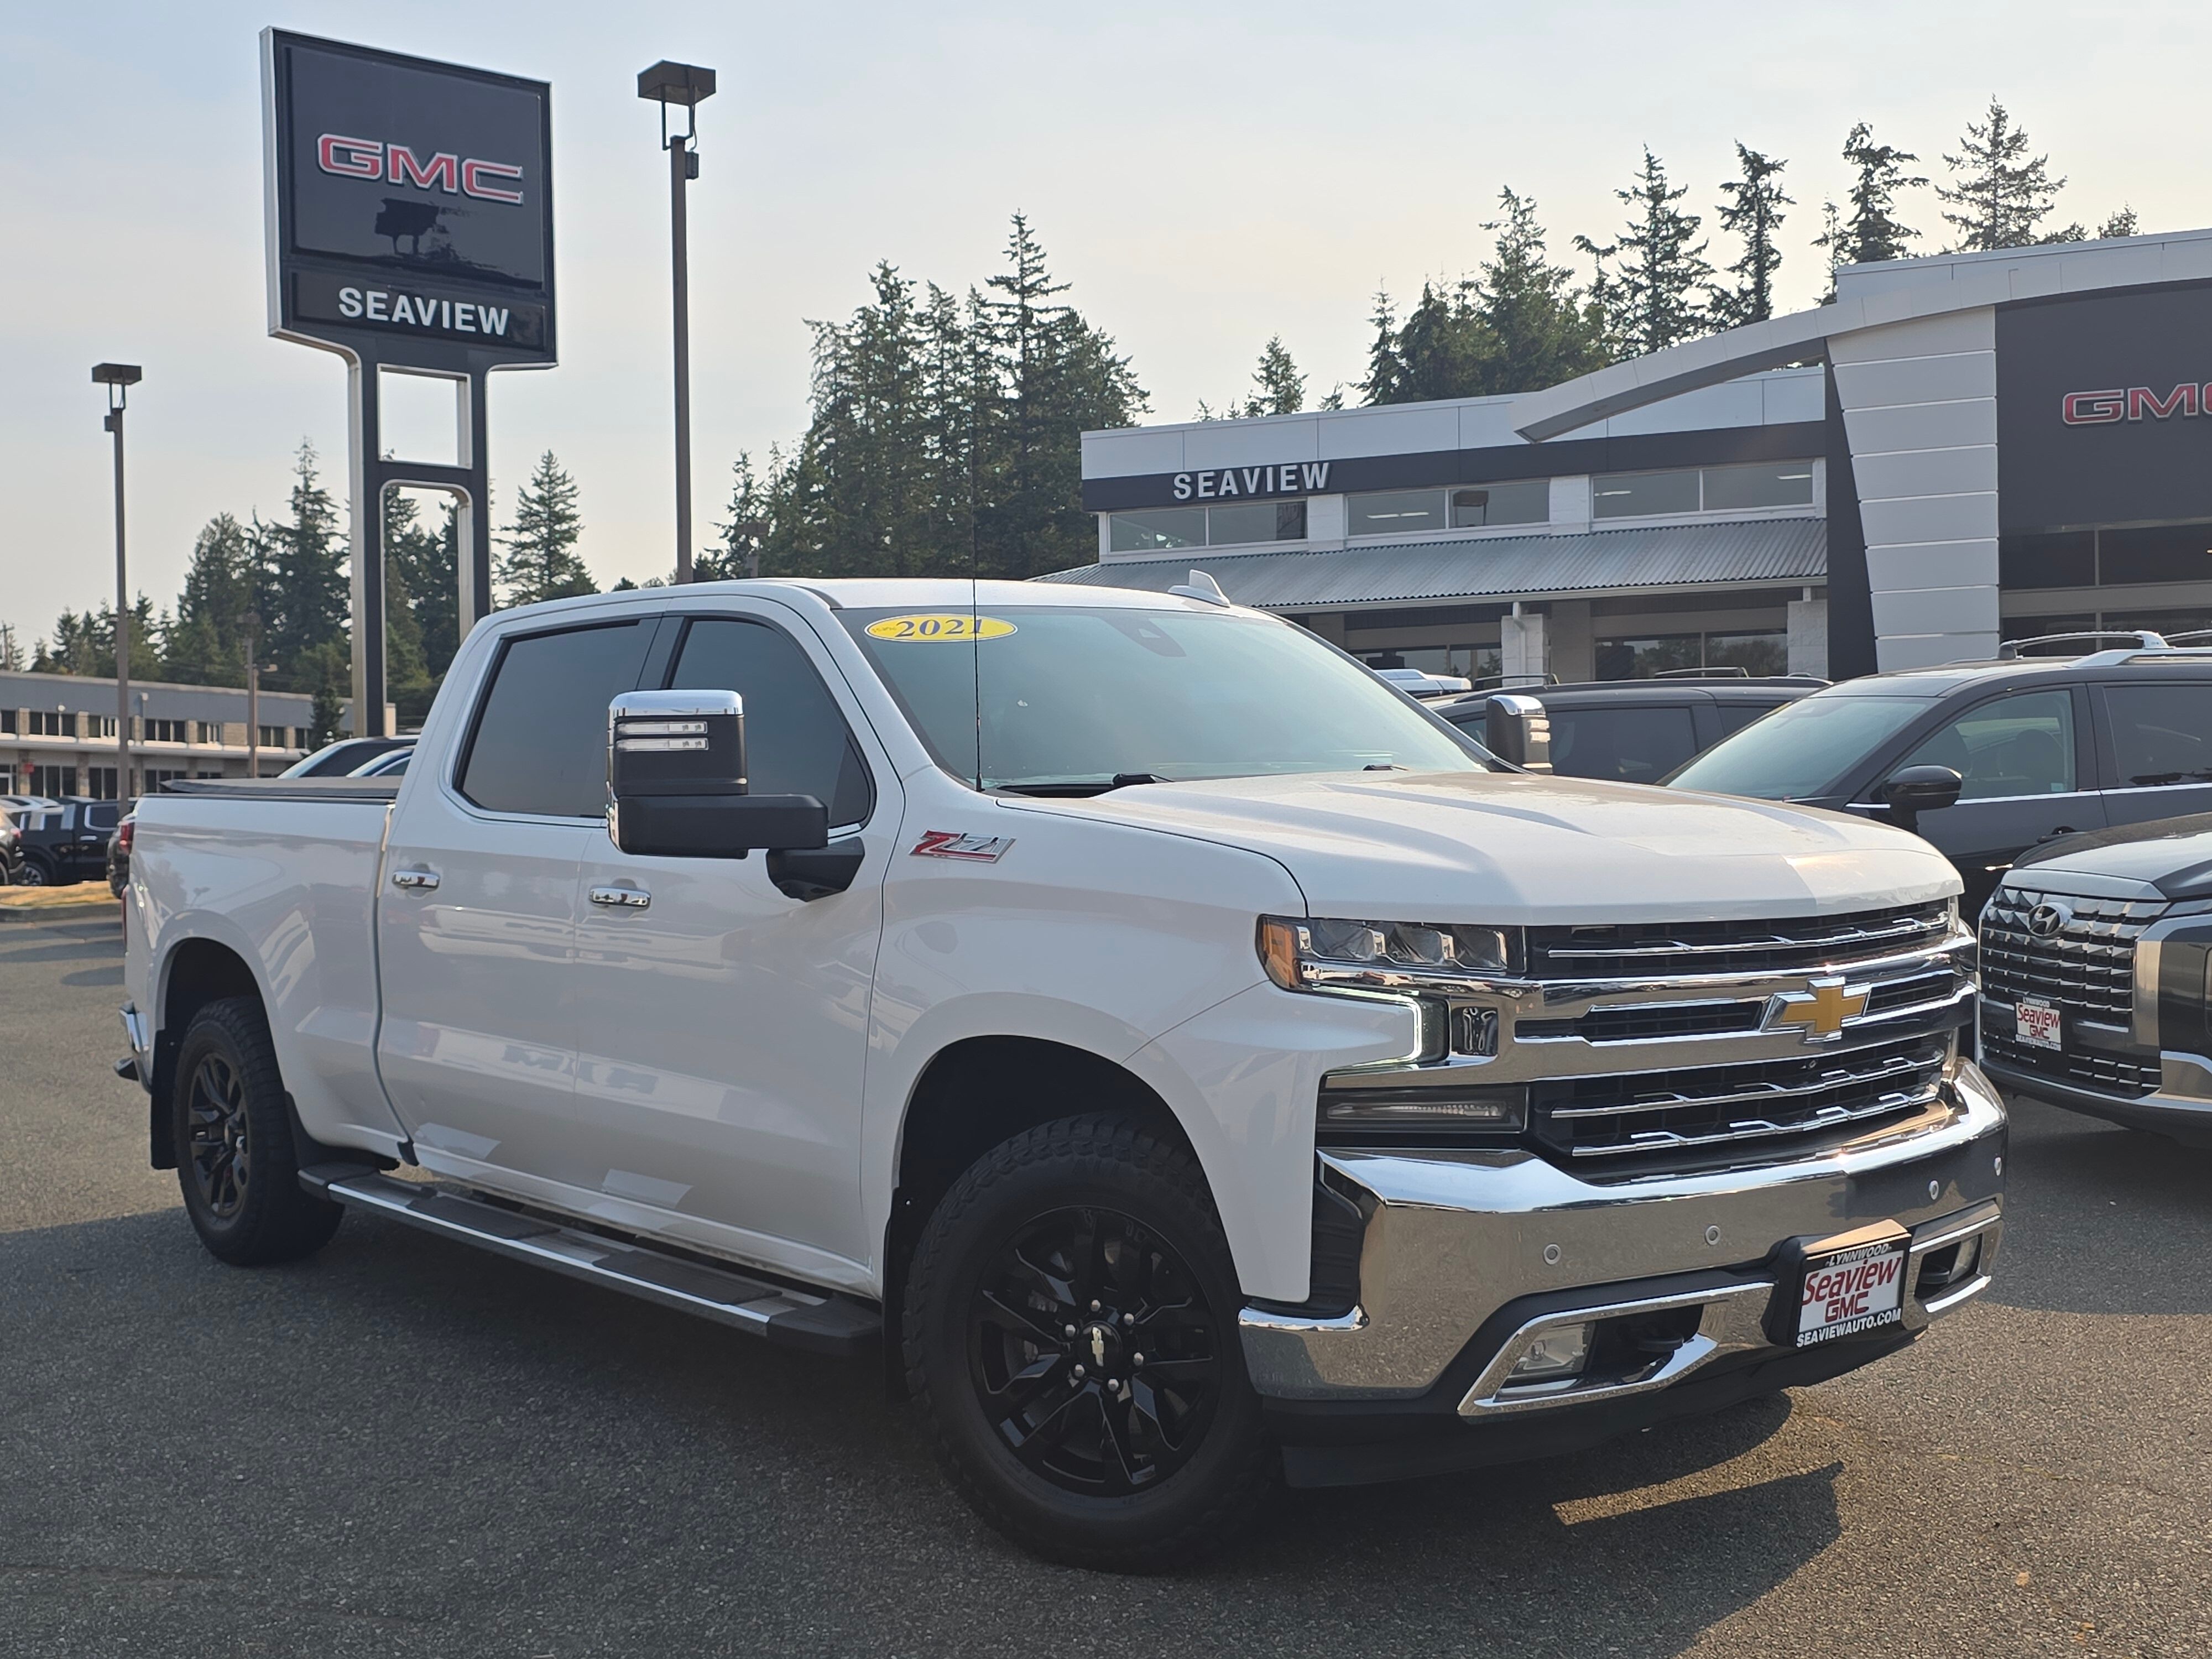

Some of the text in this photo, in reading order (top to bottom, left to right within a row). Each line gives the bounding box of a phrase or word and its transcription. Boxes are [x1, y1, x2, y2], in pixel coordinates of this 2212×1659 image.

[317, 134, 523, 204] GMC
[338, 287, 509, 336] SEAVIEW
[2063, 382, 2212, 425] GM
[1173, 462, 1329, 499] SEAVIEW
[895, 619, 984, 637] 2021
[909, 830, 1016, 864] Z71
[2017, 1004, 2062, 1029] Seaview
[2030, 1024, 2050, 1039] GMC
[1828, 1243, 1890, 1266] LYNNWOOD
[1802, 1256, 1902, 1306] Seaview
[1825, 1291, 1869, 1323] GMC
[1797, 1308, 1902, 1348] SEAVIEWAUTO.COM
